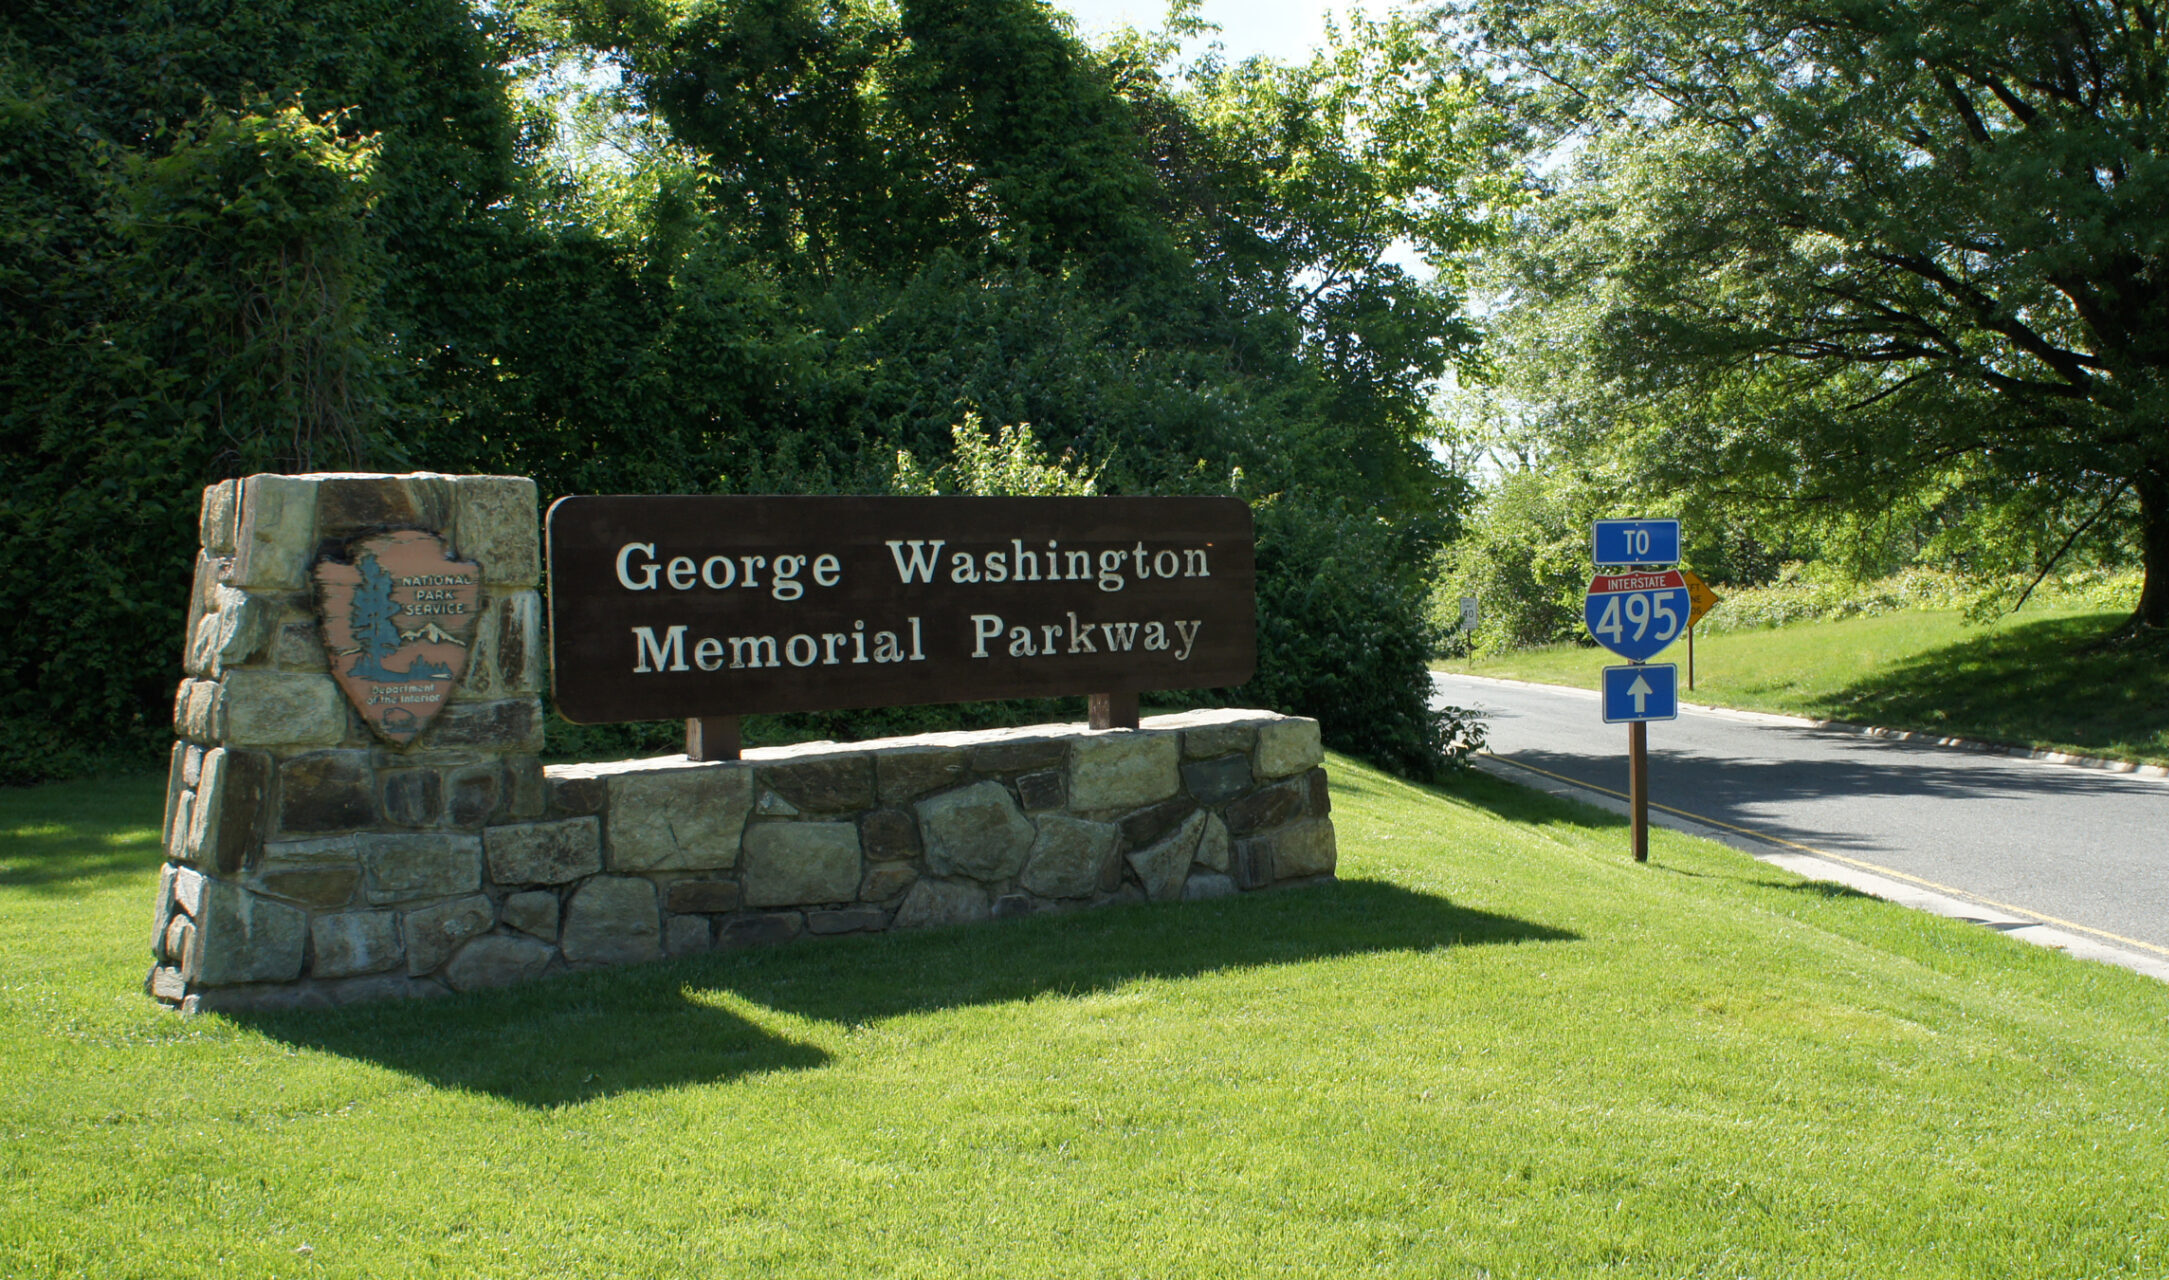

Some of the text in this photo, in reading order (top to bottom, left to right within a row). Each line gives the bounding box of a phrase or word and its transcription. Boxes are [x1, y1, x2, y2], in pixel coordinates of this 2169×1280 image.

[1623, 529, 1650, 555] TO
[614, 539, 1211, 601] George Washington
[402, 575, 472, 586] NATIONAL
[1607, 575, 1667, 591] INTERSTATE
[416, 590, 455, 600] PARK
[405, 603, 464, 615] SERVICE
[1463, 609, 1474, 618] 40
[1595, 591, 1677, 644] 495
[631, 612, 1202, 674] Memorial Parkway
[372, 684, 435, 695] Department
[367, 694, 441, 705] of the Interior
